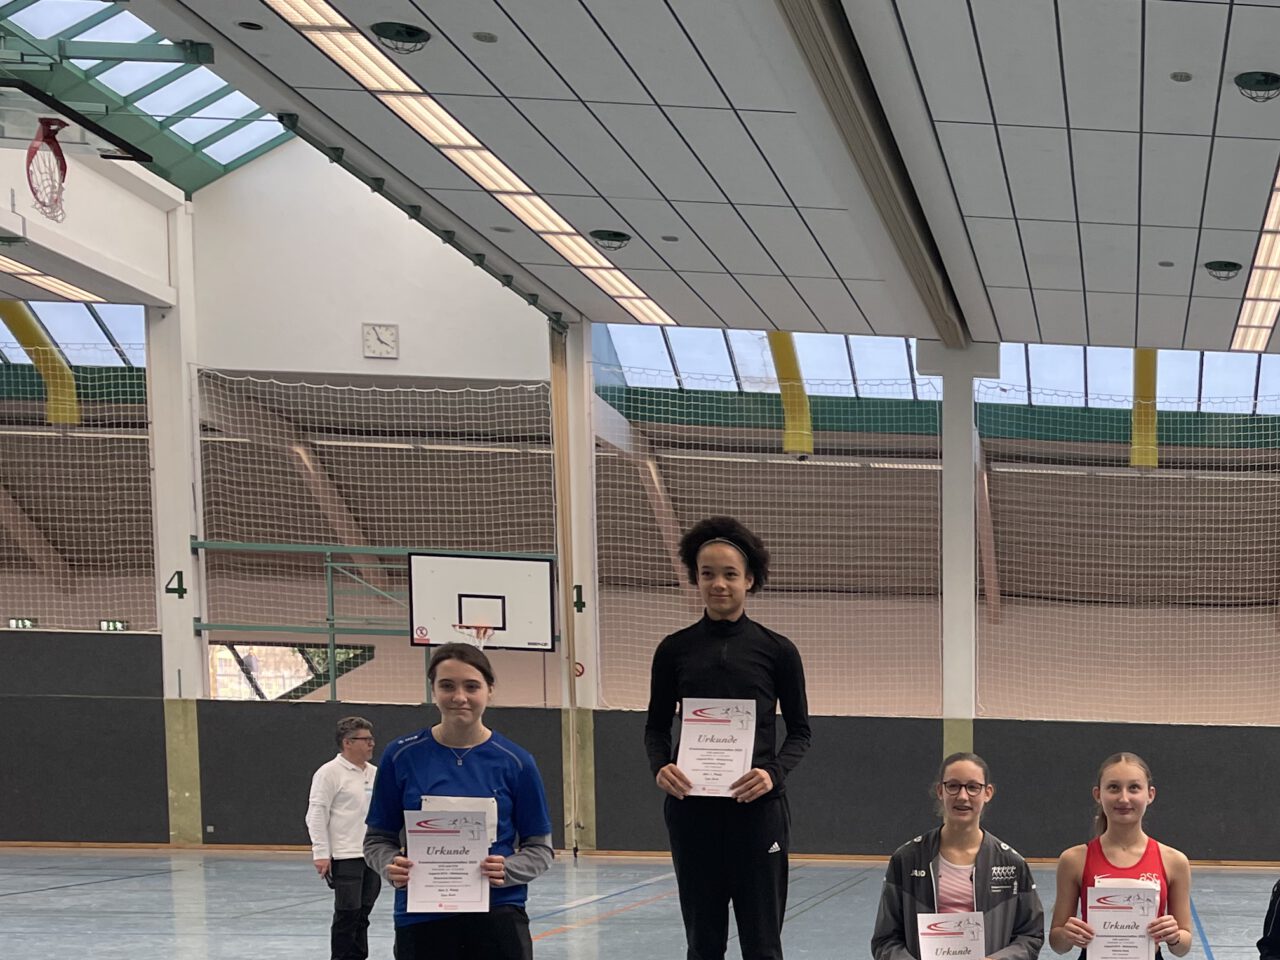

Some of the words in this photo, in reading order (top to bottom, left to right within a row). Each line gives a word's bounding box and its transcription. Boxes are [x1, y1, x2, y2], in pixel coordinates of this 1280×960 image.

[165, 570, 187, 600] 4
[697, 734, 738, 744] Urkunde
[426, 846, 470, 856] Urkunde
[1103, 920, 1140, 930] Urkunde
[935, 946, 972, 956] Urkunde
